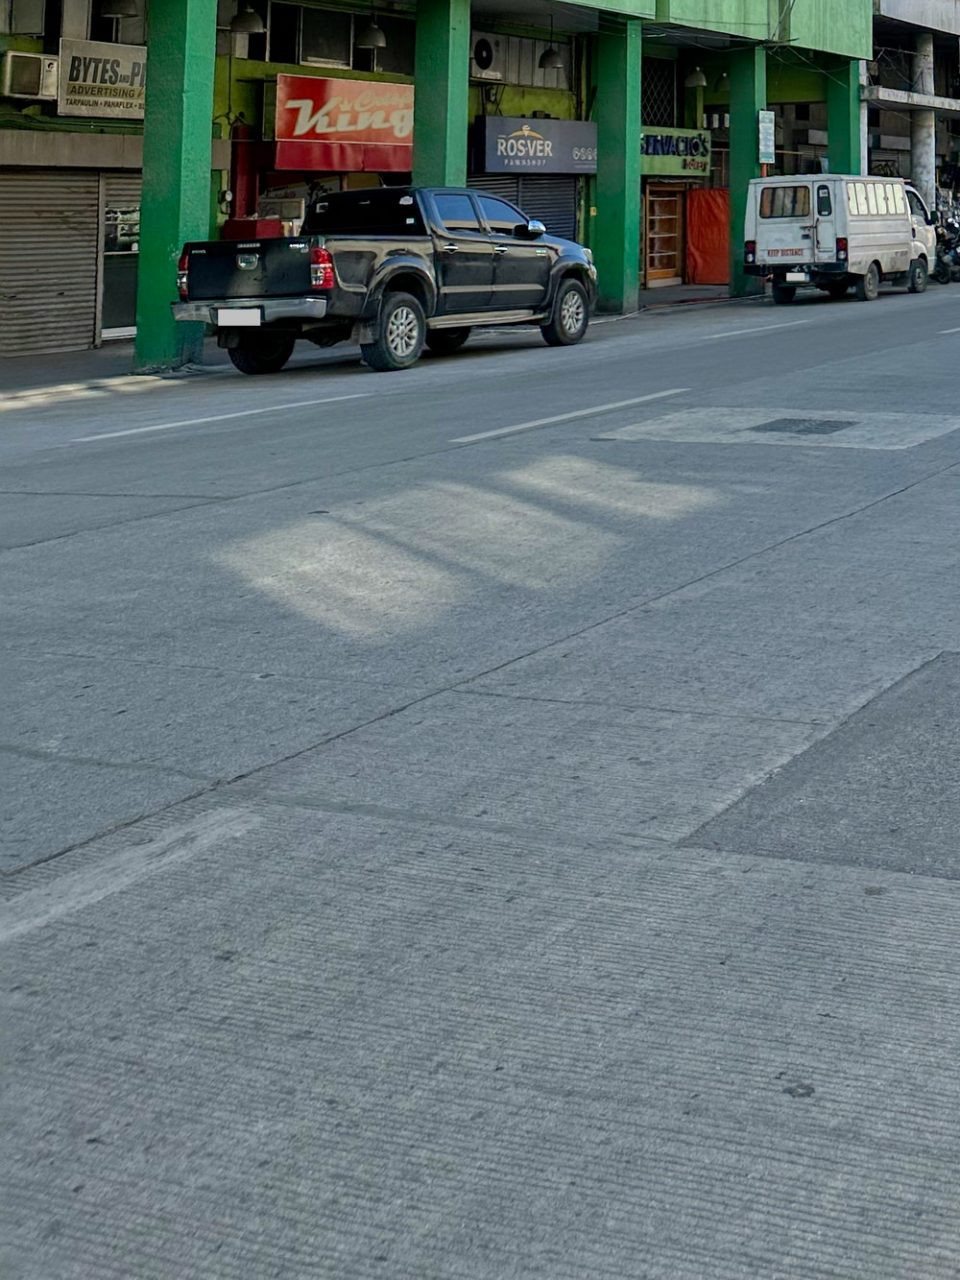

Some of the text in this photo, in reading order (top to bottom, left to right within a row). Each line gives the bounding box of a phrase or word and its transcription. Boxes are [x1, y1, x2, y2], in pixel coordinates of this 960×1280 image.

[69, 56, 121, 85] BYTES
[70, 85, 135, 98] ADVERTISING
[66, 98, 99, 107] TARPAULIN
[284, 95, 415, 138] King
